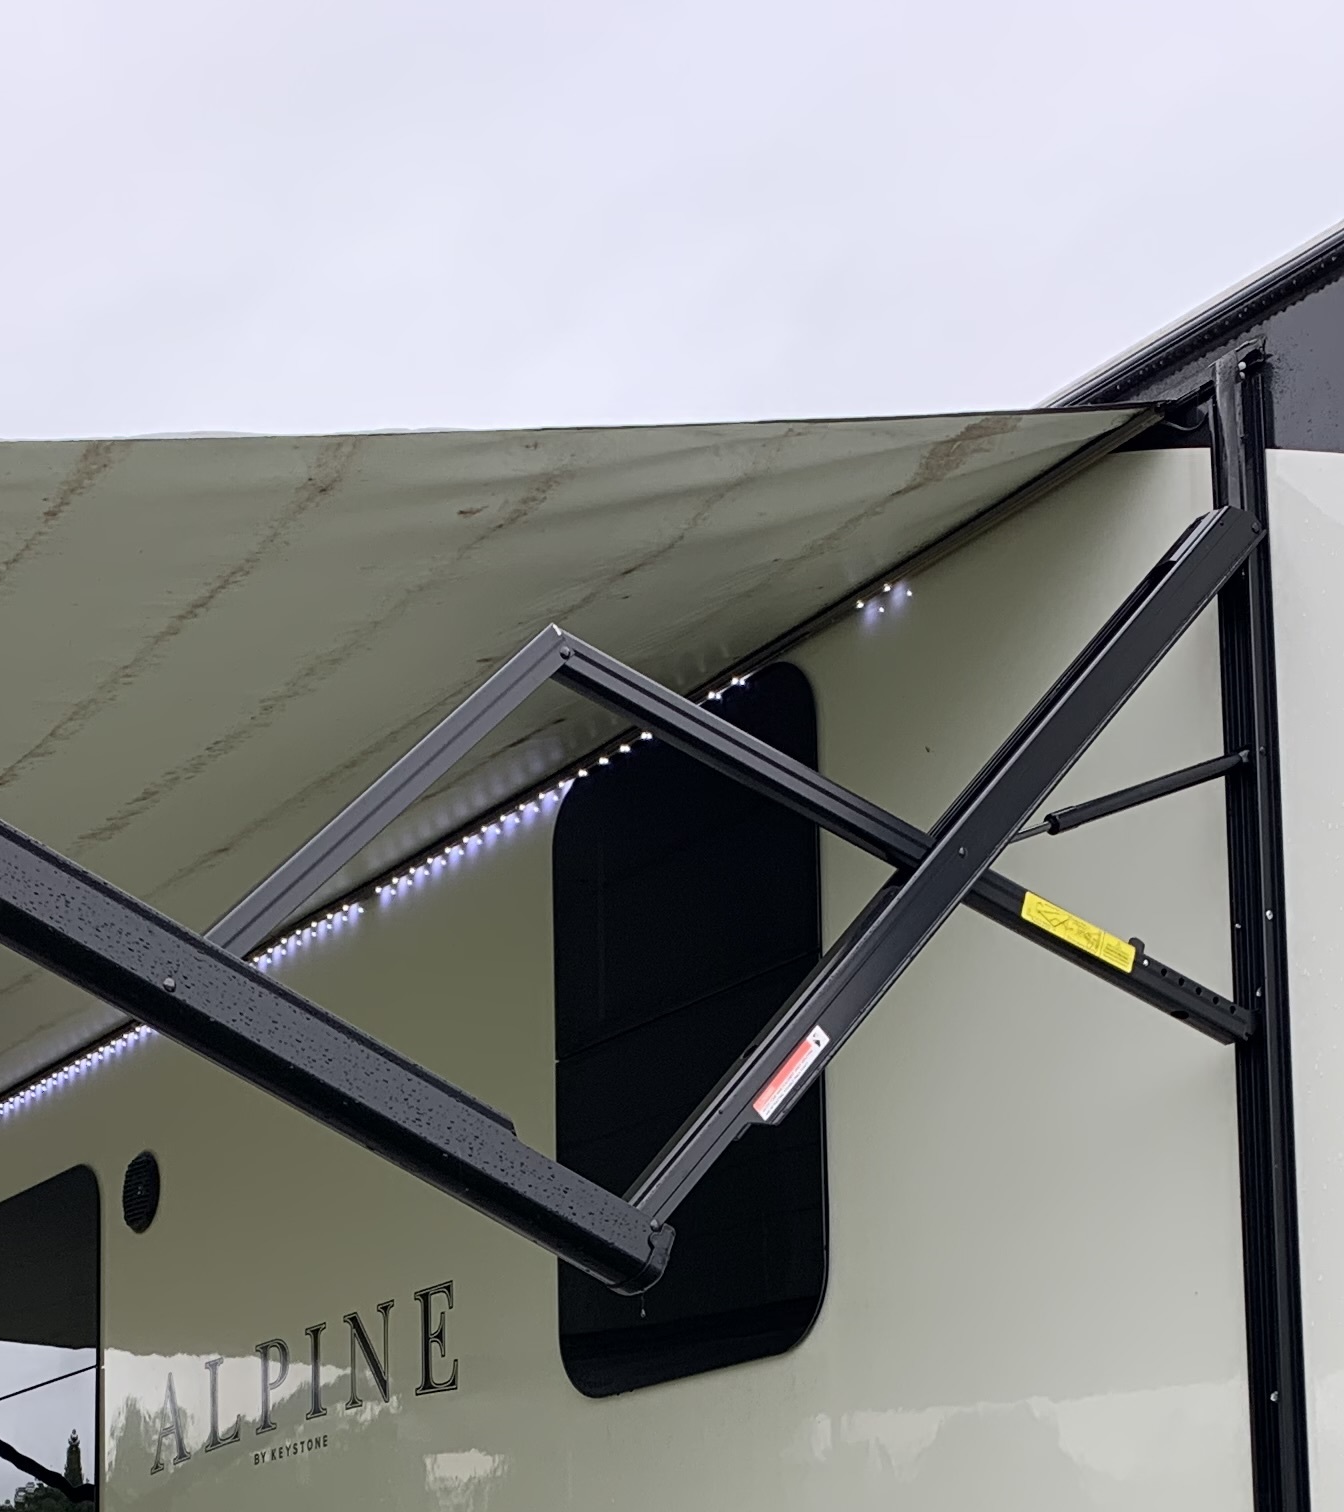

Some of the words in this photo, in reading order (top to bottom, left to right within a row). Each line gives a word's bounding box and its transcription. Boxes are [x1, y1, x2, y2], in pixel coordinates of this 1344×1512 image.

[150, 1280, 458, 1475] ALPINE
[254, 1451, 266, 1465] BY
[271, 1434, 328, 1461] KEYSTONE
